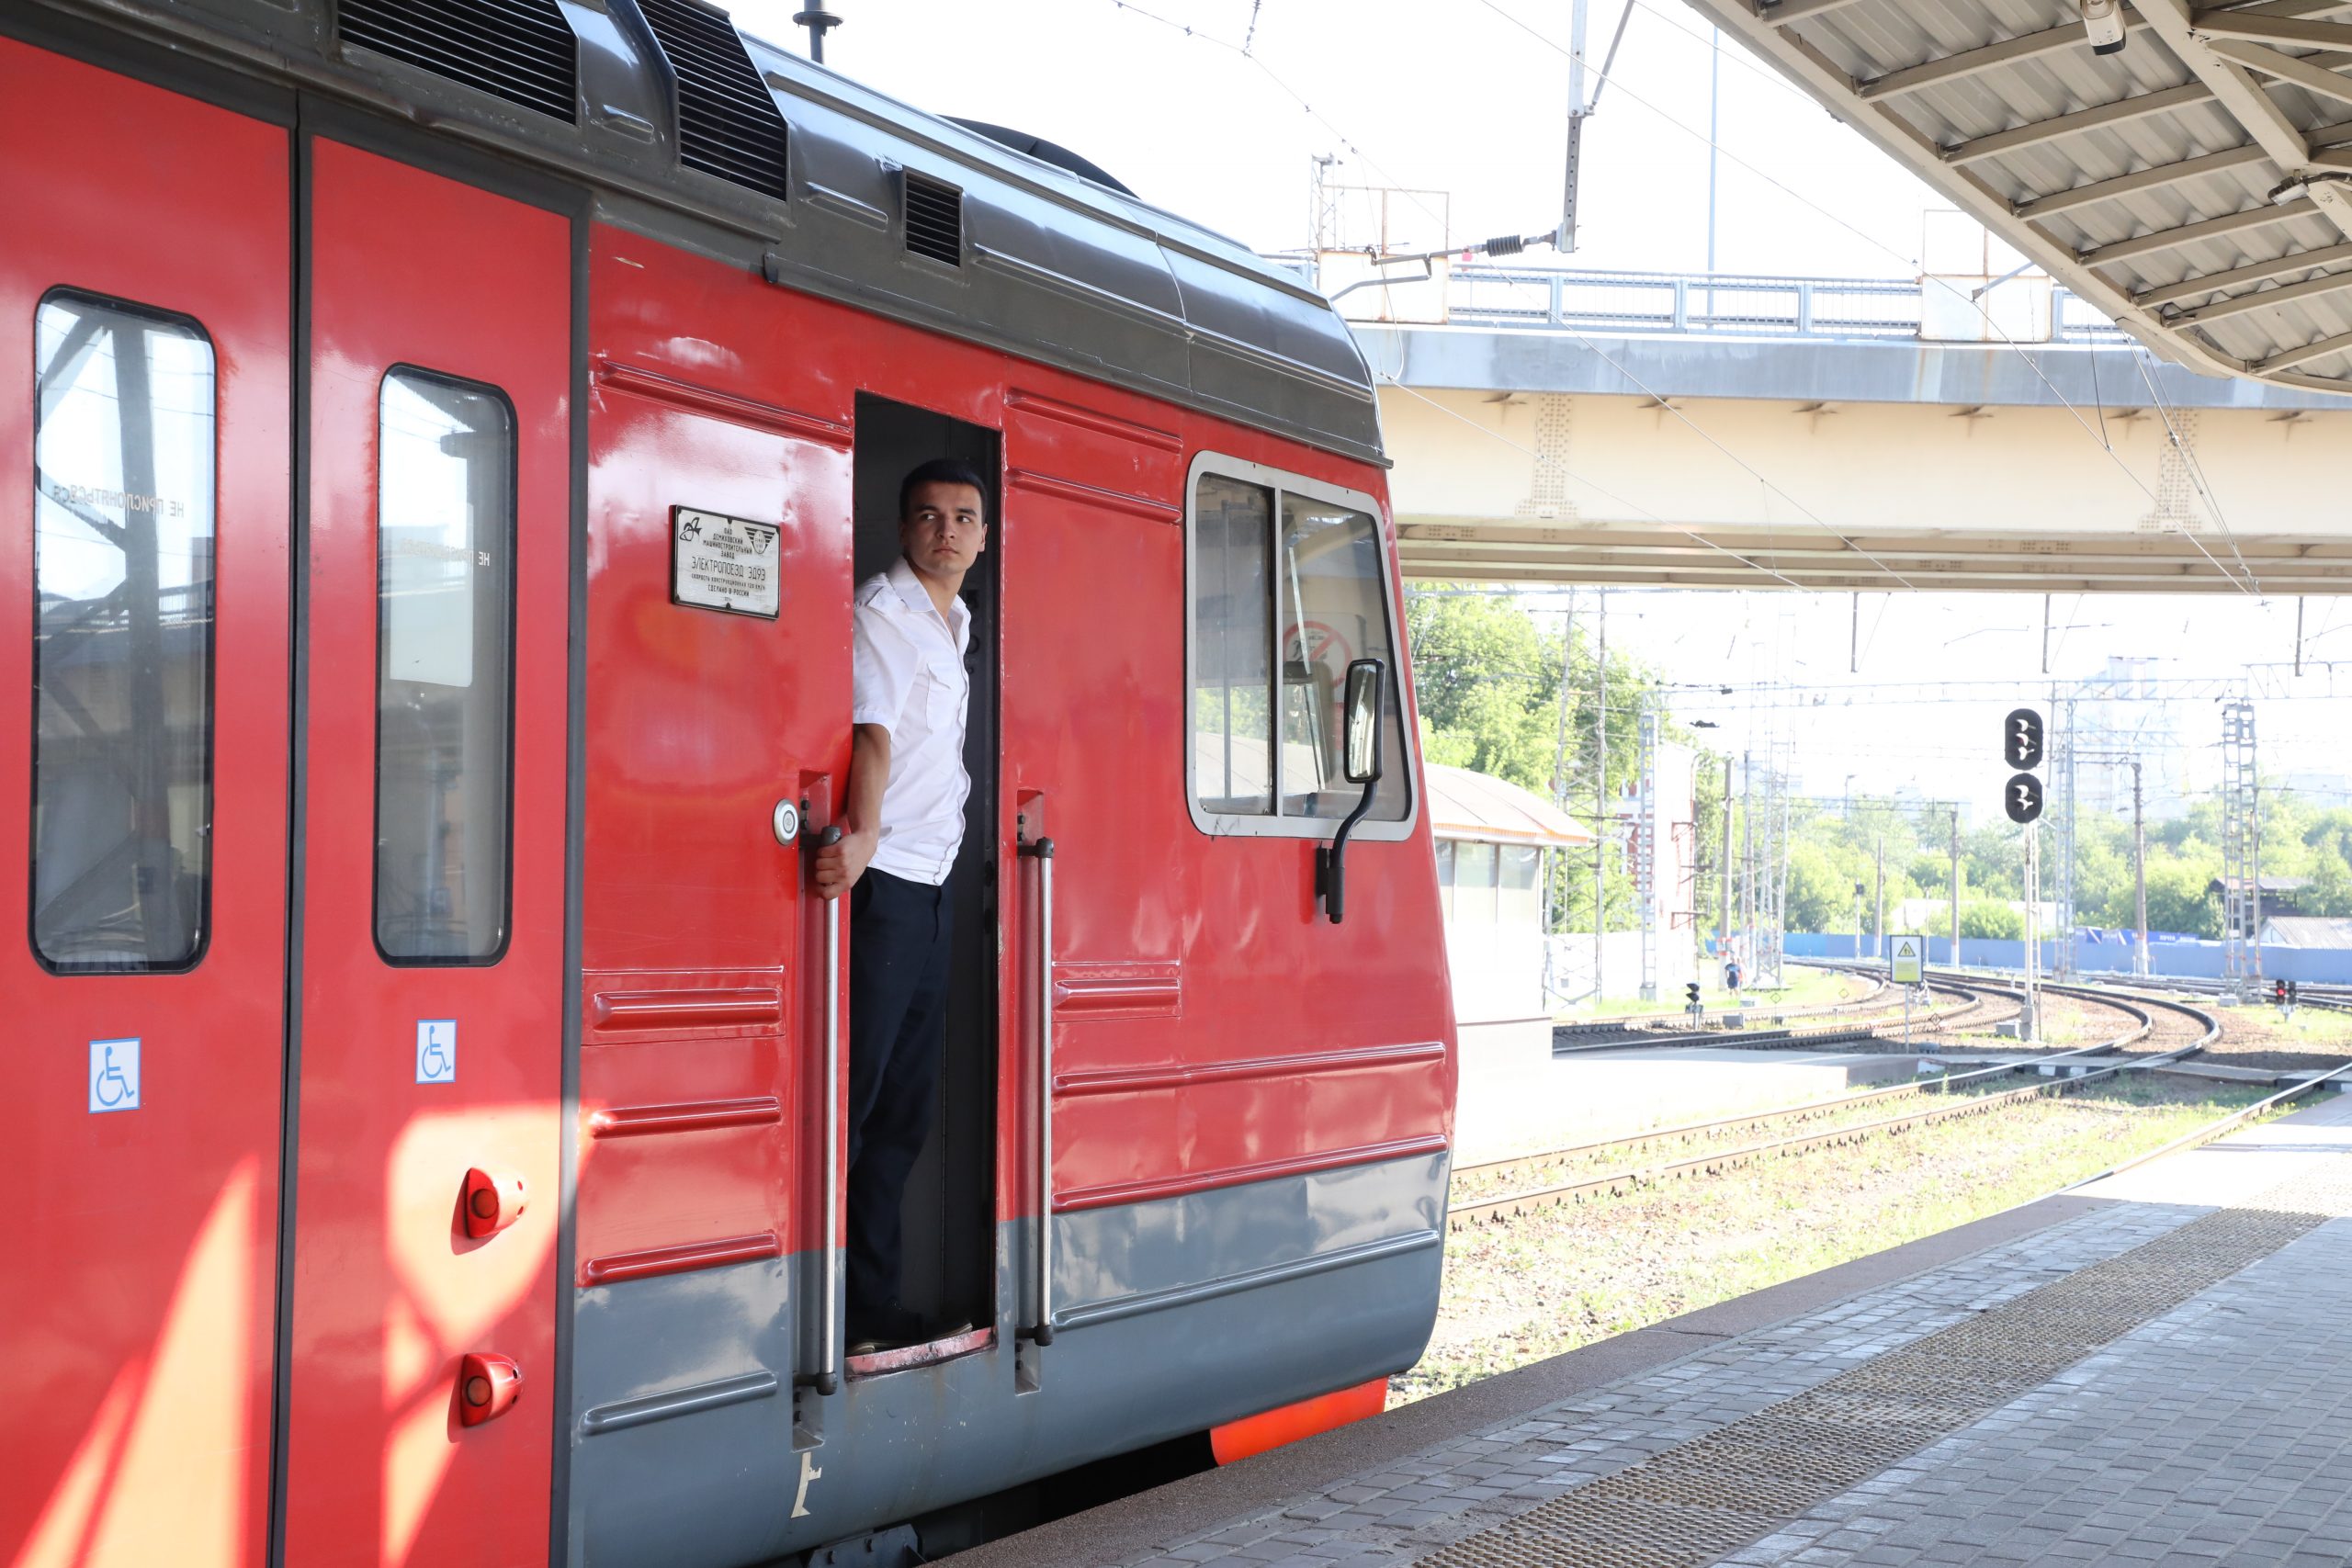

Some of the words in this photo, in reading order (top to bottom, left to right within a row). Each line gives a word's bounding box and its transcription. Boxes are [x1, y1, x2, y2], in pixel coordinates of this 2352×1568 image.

[720, 550, 735, 559] ЗАВОД
[691, 556, 744, 578] ЭЛЕКТРОПОЕЗД
[707, 584, 728, 593] СДЕЛАНО
